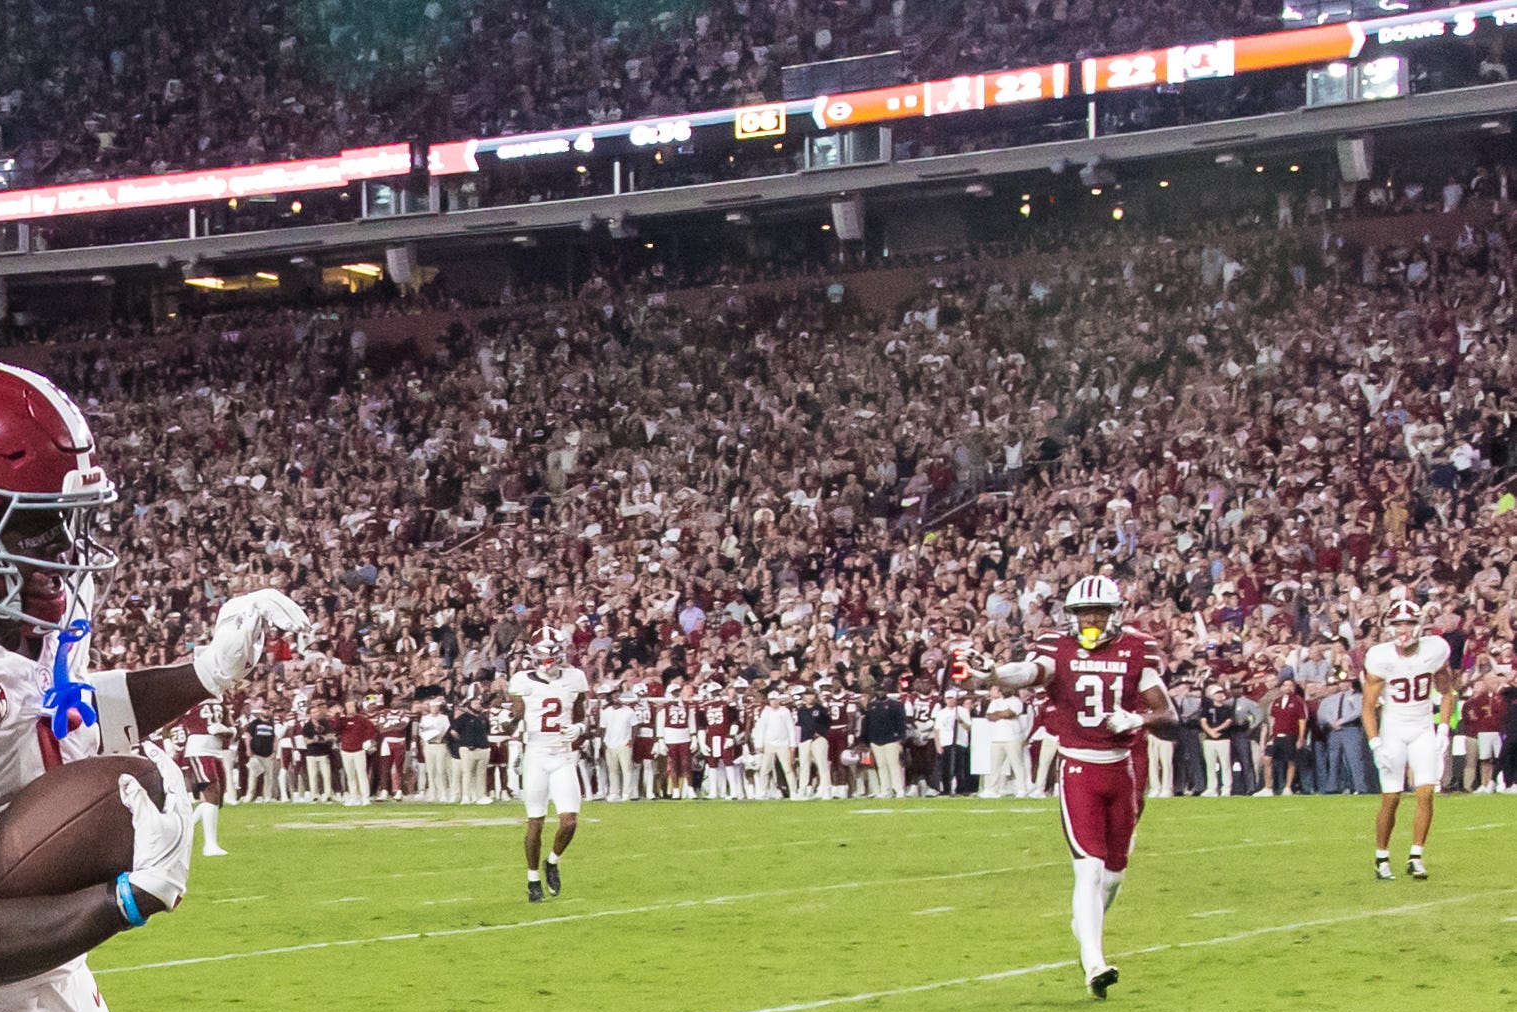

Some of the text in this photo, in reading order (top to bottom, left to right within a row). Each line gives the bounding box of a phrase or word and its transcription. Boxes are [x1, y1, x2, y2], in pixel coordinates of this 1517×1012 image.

[1453, 11, 1477, 36] 3
[995, 72, 1042, 104] 22
[1106, 56, 1156, 88] 22
[573, 132, 594, 152] 4
[741, 111, 778, 133] 06
[1069, 660, 1128, 674] CAROLINA
[1075, 674, 1124, 728] 31
[1389, 672, 1434, 703] 30
[540, 697, 562, 733] 2
